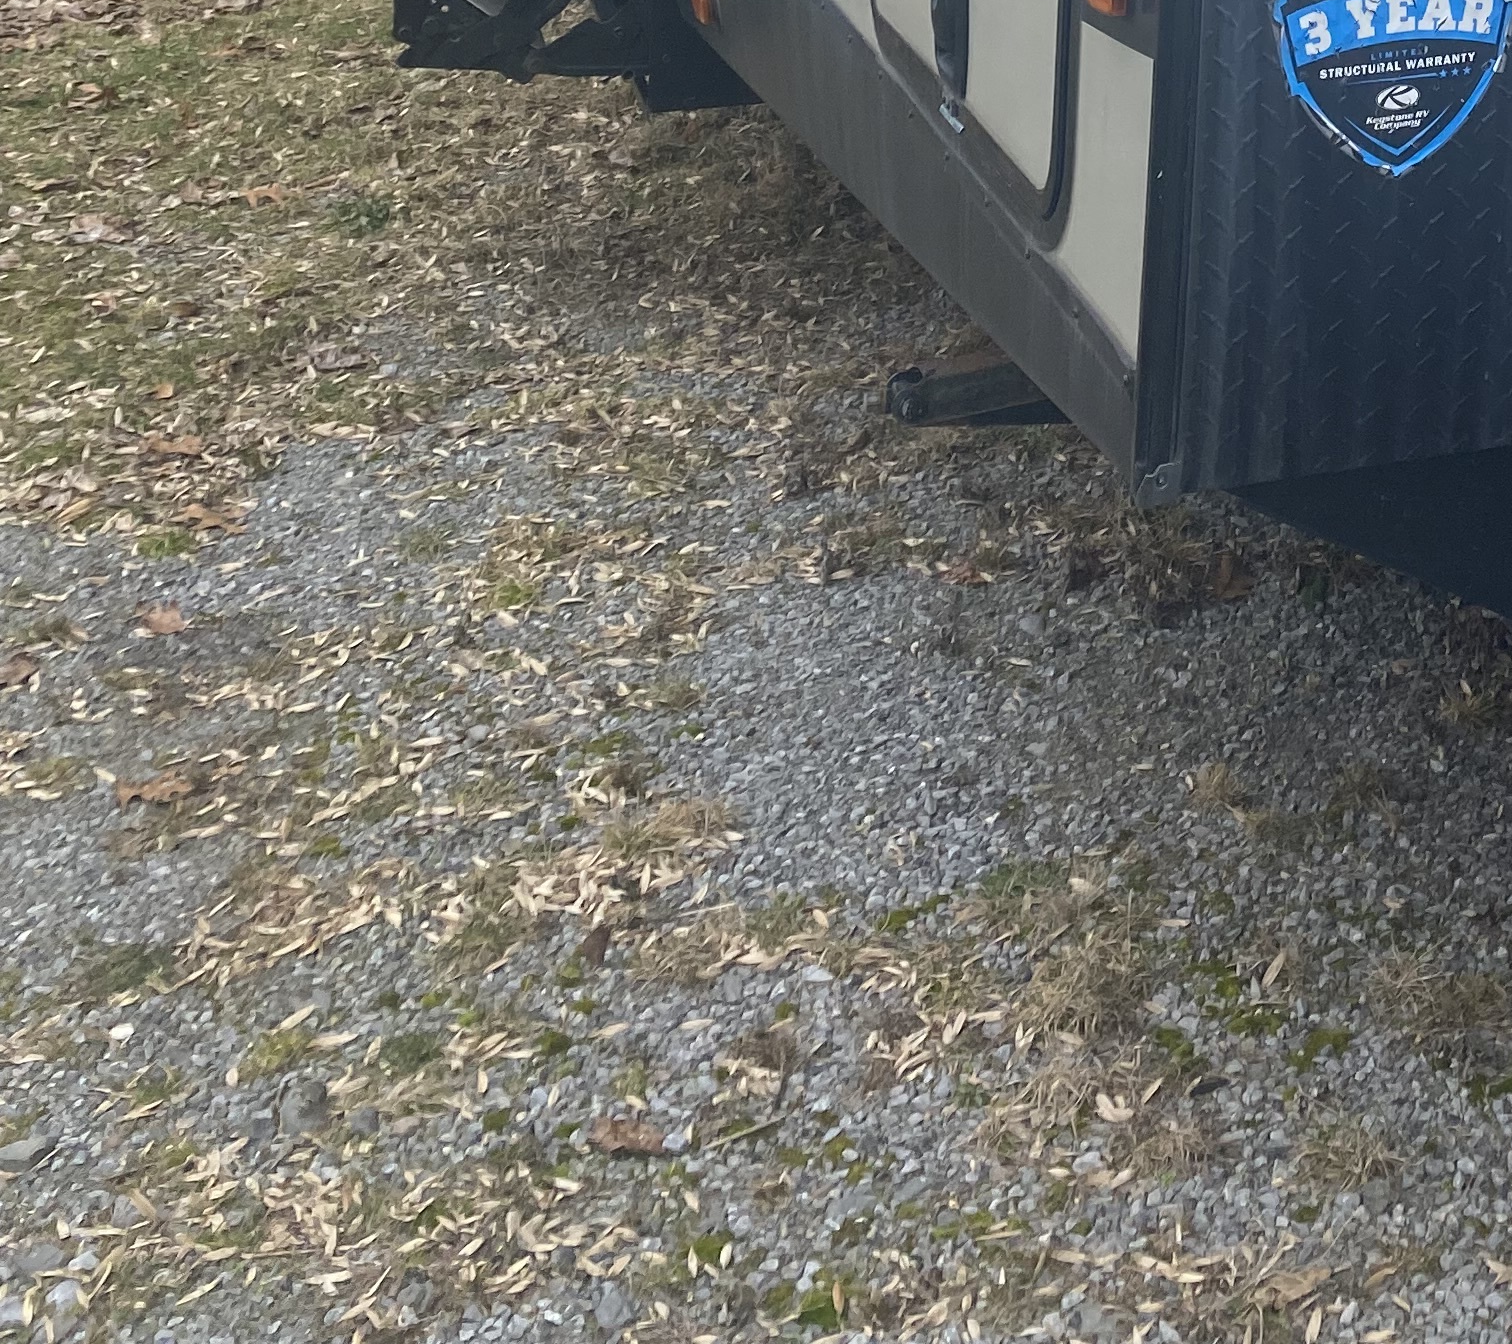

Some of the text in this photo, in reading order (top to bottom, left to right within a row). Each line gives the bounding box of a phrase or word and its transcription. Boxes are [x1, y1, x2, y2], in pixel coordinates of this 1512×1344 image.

[1299, 10, 1332, 56] 3
[1319, 51, 1476, 80] STRUCTURAL WARRANTY
[1415, 109, 1431, 119] RV
